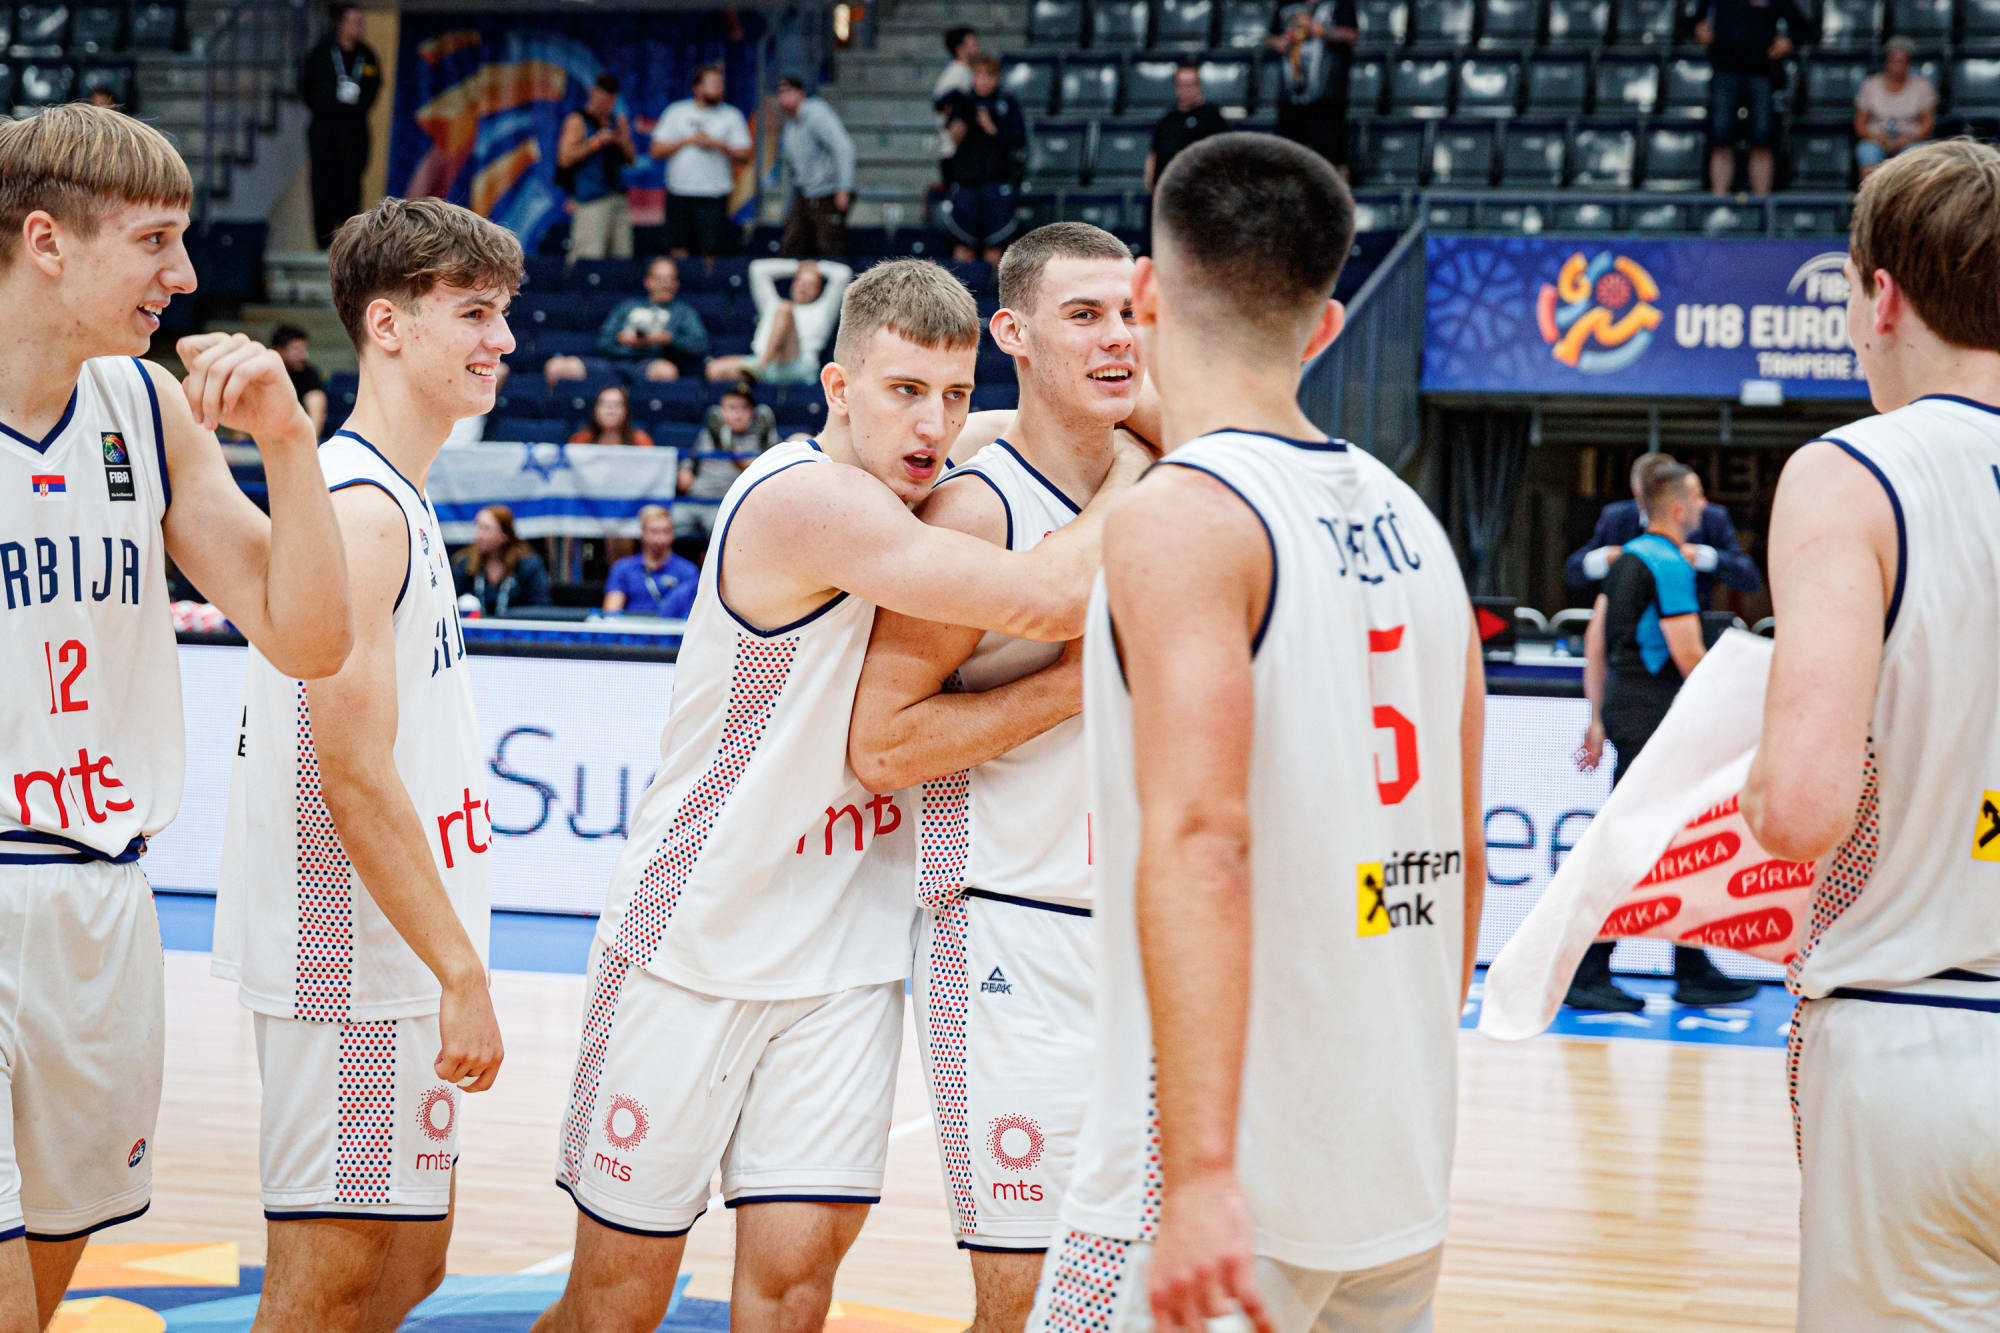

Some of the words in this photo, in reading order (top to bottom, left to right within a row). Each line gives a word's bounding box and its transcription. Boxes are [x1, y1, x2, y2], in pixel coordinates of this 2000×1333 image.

[1675, 304, 1744, 348] U18
[1756, 352, 1852, 380] TAMPERE
[109, 471, 130, 484] FIBA
[0, 536, 139, 610] RBIJA
[44, 639, 89, 714] 12
[1367, 624, 1421, 806] 5
[13, 748, 135, 829] mts
[980, 981, 1012, 995] PEAK
[416, 1149, 451, 1170] mts
[593, 1152, 633, 1183] mts
[993, 1179, 1044, 1202] mts
